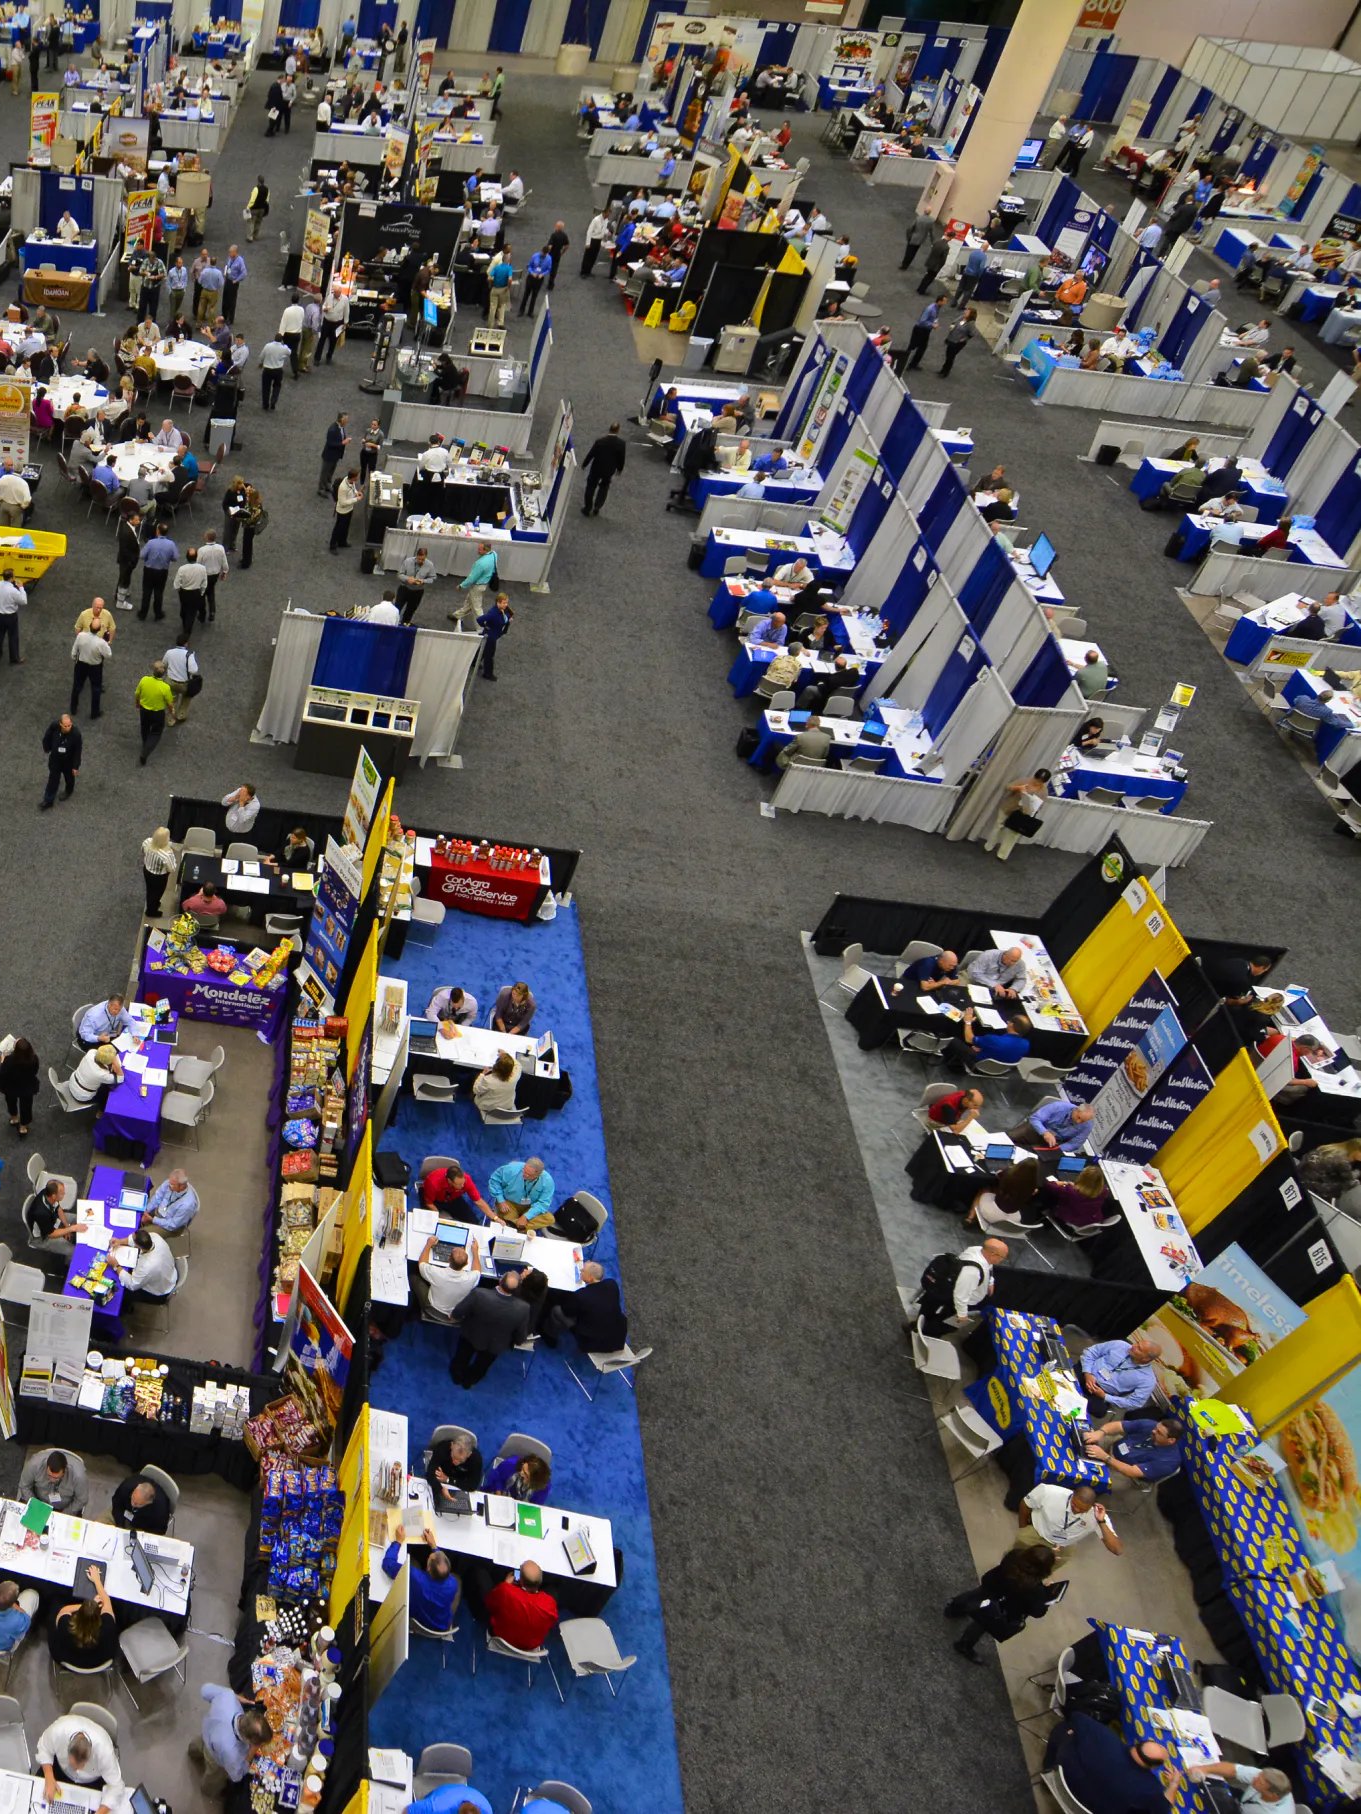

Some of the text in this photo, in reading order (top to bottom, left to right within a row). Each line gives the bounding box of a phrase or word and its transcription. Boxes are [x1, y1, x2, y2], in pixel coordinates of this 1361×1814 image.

[132, 196, 153, 209] PEAK
[380, 225, 420, 235] AdvancePierre
[43, 288, 70, 297] IDAHOAN
[338, 866, 356, 893] Profits
[445, 874, 490, 889] ConAgra
[454, 883, 518, 902] Foodservice
[473, 896, 494, 904] SERVICE
[1147, 915, 1161, 934] 819
[192, 983, 271, 1006] Mondelēz
[305, 986, 321, 1009] PARTNER
[1129, 996, 1168, 1010] LambWesto
[214, 998, 263, 1010] International
[1096, 1034, 1137, 1050] LambWeston
[1080, 1053, 1120, 1069] LambWeston
[1064, 1073, 1103, 1087] LambWeston
[1168, 1074, 1210, 1091] LambWeston
[1151, 1094, 1193, 1112] LambWeston
[1135, 1113, 1175, 1132] LambWeston
[1120, 1133, 1158, 1151] LambWeston
[1283, 1184, 1298, 1203] 817
[1311, 1246, 1328, 1268] 815
[1215, 1252, 1296, 1337] timeless
